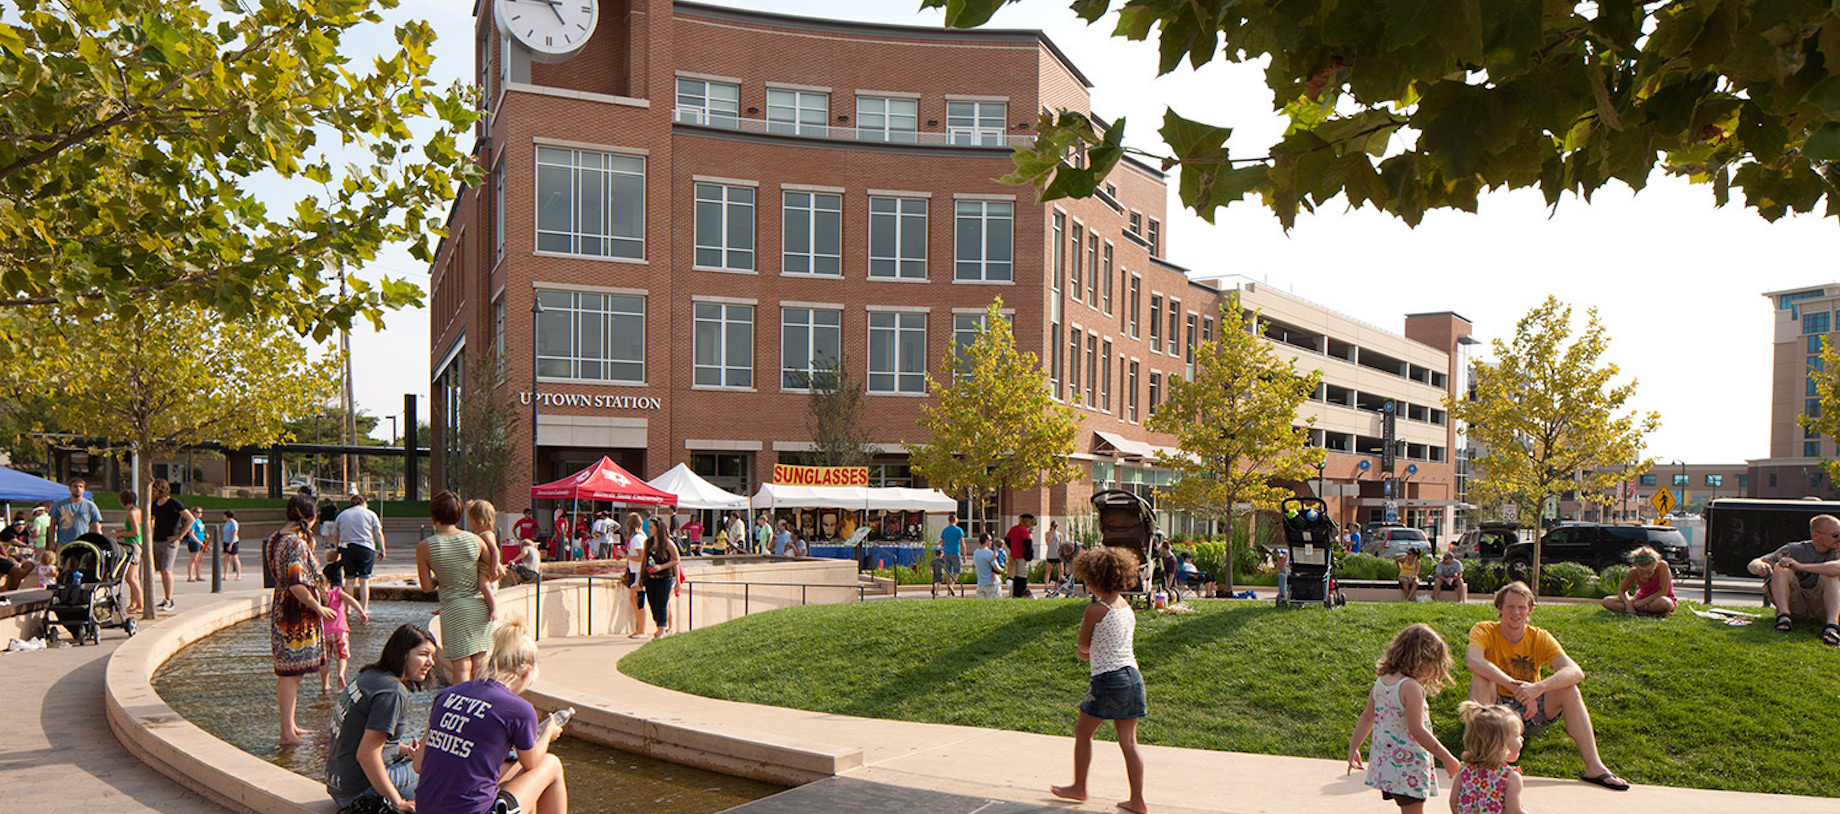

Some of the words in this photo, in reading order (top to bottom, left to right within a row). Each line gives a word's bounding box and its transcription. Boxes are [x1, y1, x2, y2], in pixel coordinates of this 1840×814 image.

[594, 394, 661, 409] STATION
[774, 466, 867, 485] SUNGLASSES
[443, 693, 493, 719] WE'VE
[440, 712, 470, 733] GOT
